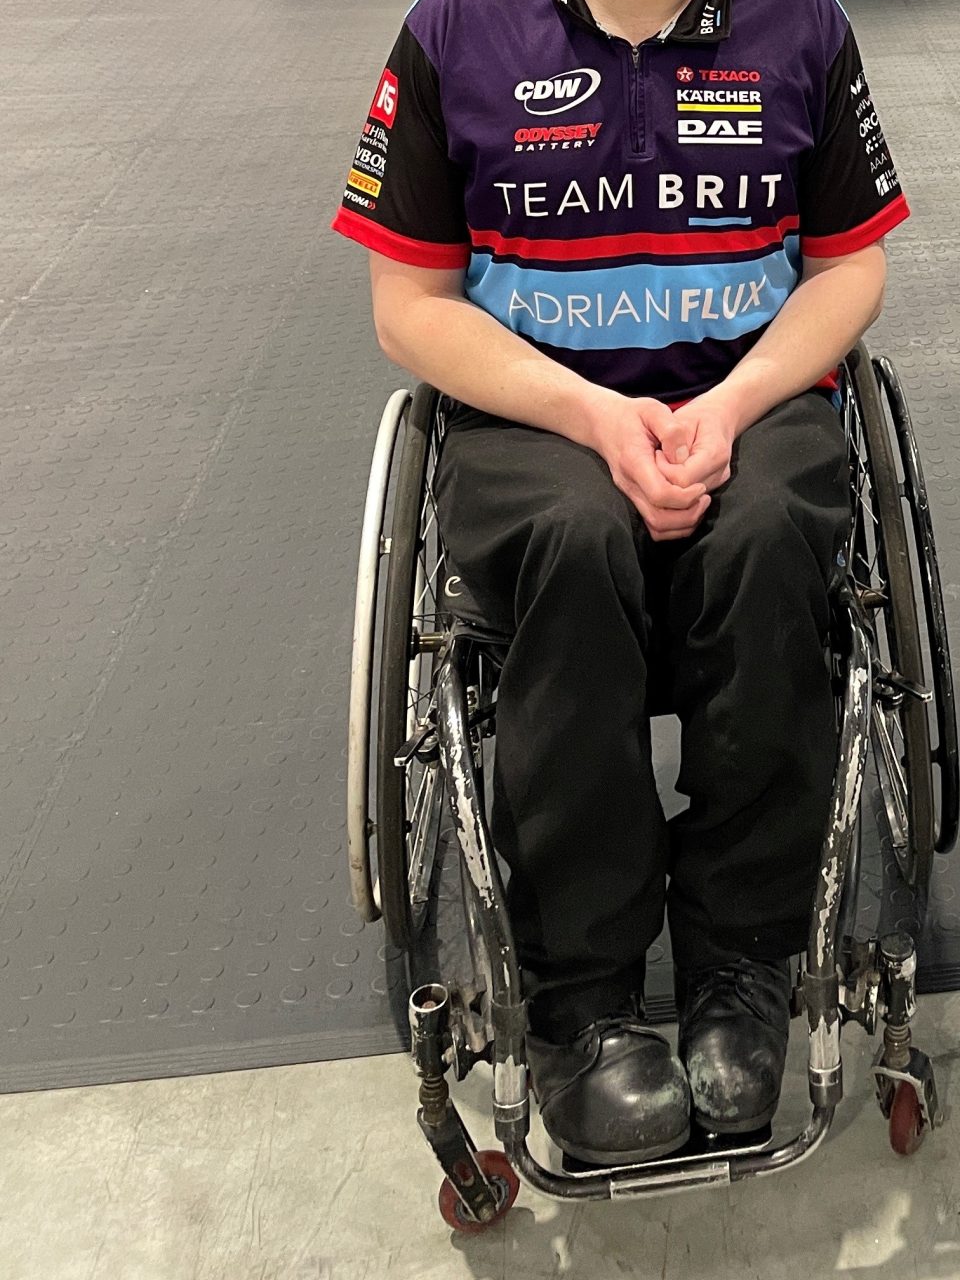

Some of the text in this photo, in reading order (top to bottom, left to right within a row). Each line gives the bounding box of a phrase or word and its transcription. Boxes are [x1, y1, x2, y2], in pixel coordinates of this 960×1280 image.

[700, 2, 715, 35] BRIT
[699, 69, 761, 82] TEXACO
[514, 77, 582, 101] CDW
[514, 122, 602, 143] ODYSSEY
[677, 119, 763, 136] DAF
[515, 139, 595, 152] BATTERY
[494, 173, 782, 217] TEAM BRIT
[508, 274, 767, 328] ADRIANFLUX
